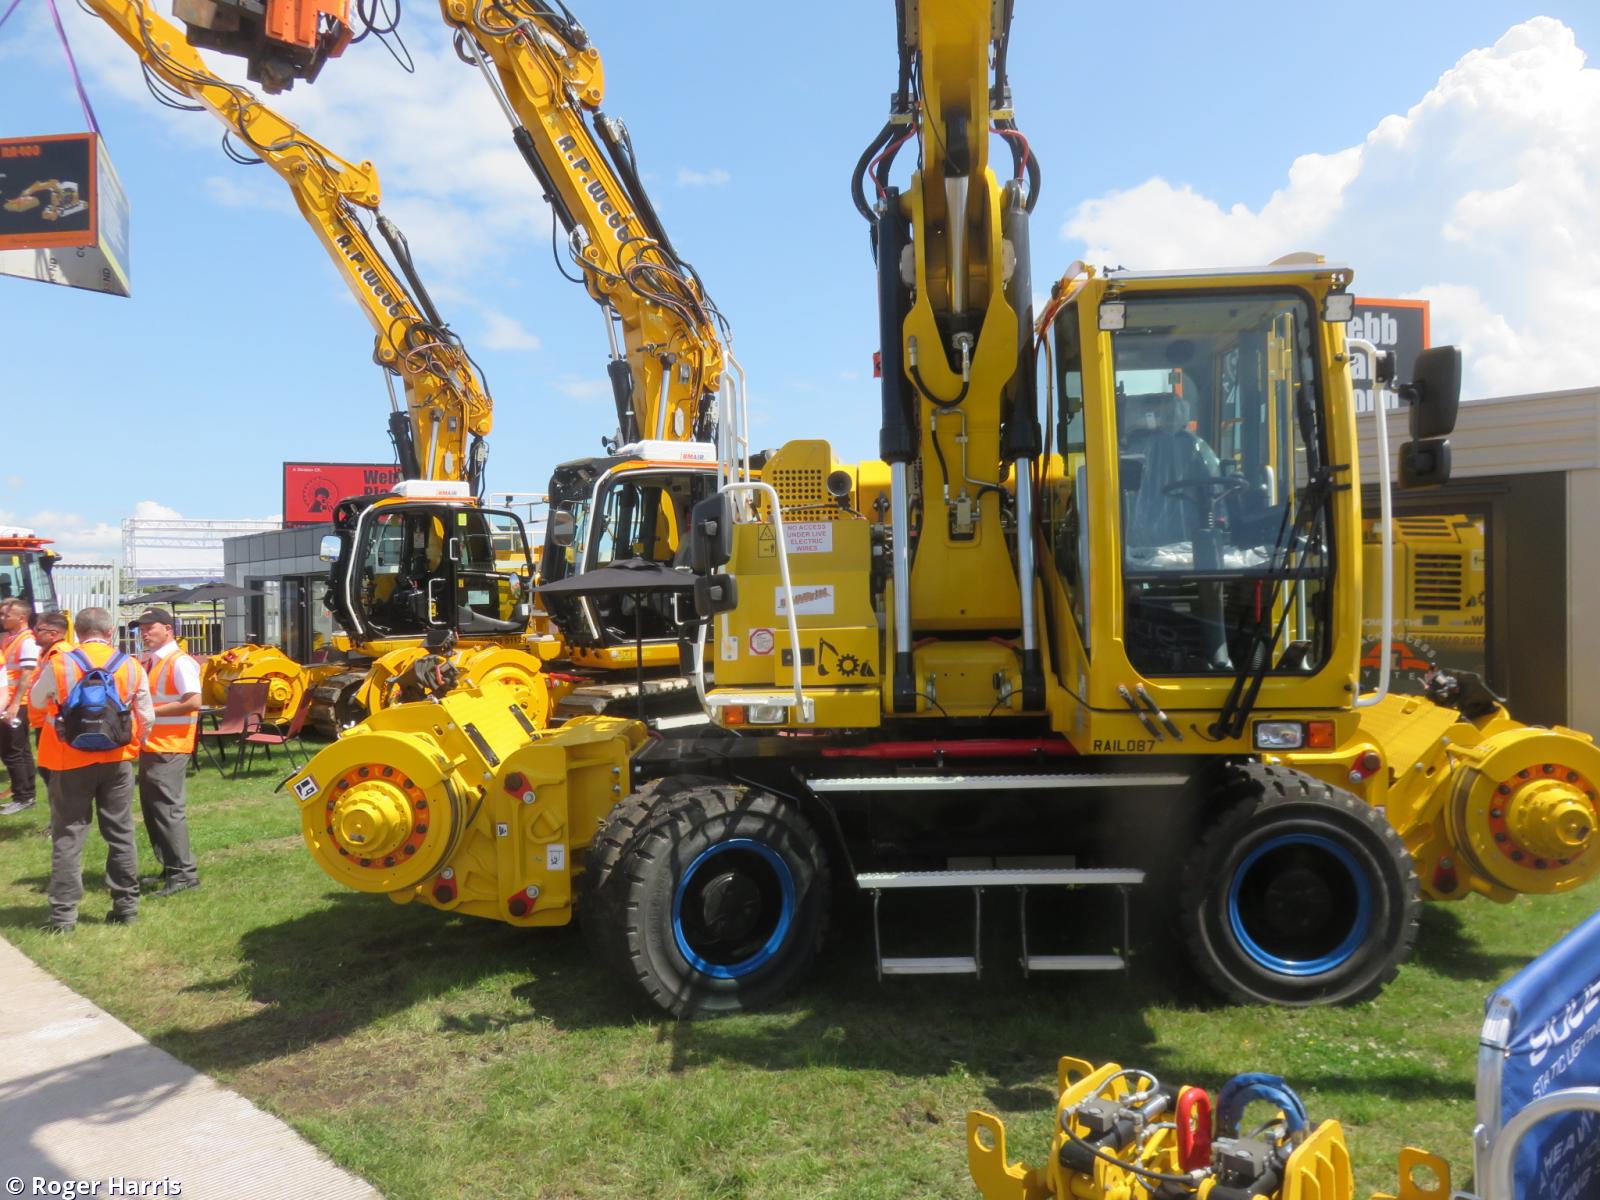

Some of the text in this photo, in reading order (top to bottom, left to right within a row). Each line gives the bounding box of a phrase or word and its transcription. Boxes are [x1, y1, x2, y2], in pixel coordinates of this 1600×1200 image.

[1346, 312, 1398, 345] ebb
[786, 531, 811, 539] UNDER
[1532, 1017, 1600, 1098] STATIC LIGHTIN
